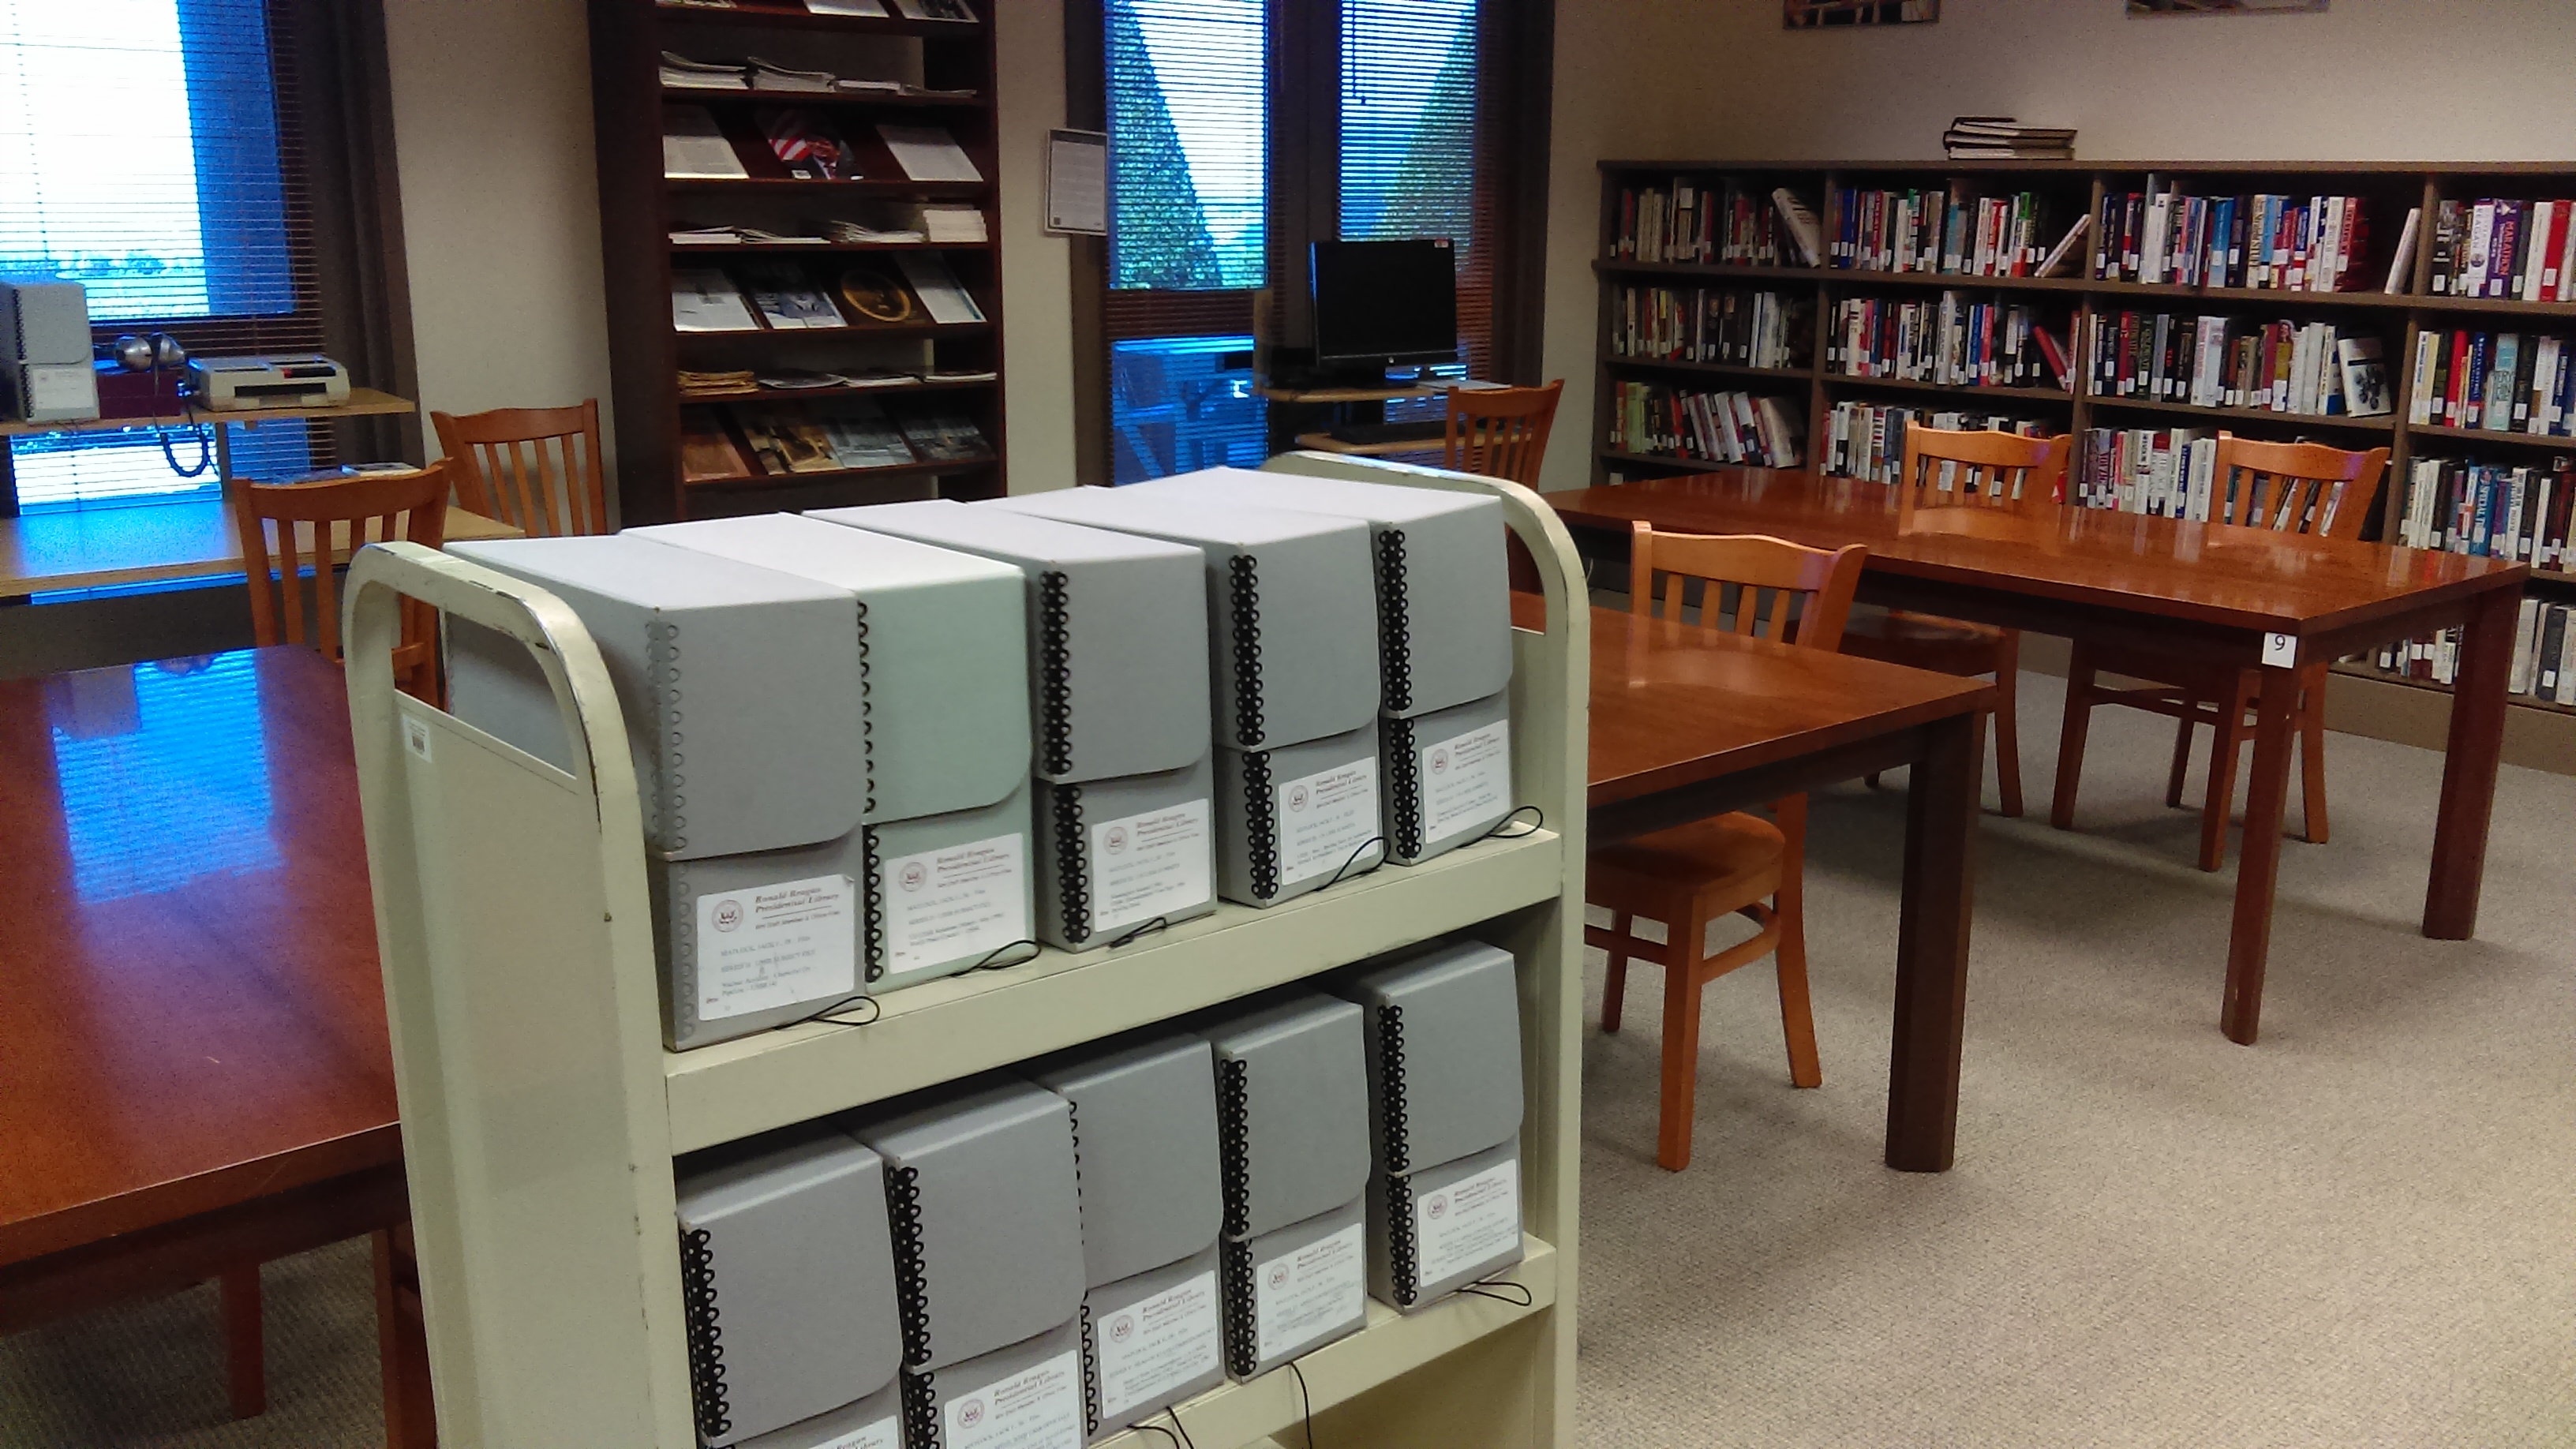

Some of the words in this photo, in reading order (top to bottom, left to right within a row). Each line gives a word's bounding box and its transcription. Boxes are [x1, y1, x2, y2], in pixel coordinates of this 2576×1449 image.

[2473, 208, 2483, 249] REAGAN
[2499, 220, 2514, 276] MARATHON
[2477, 485, 2490, 516] SPECIAL
[2275, 635, 2286, 651] 9
[754, 891, 788, 904] Ronald
[789, 886, 821, 898] Reagan
[754, 897, 805, 914] Presidential
[807, 892, 840, 904] Library
[993, 1379, 1020, 1398] Ronald
[1023, 1367, 1050, 1384] Reagan
[994, 1380, 1036, 1406] Presidential
[1038, 1368, 1065, 1386] Library
